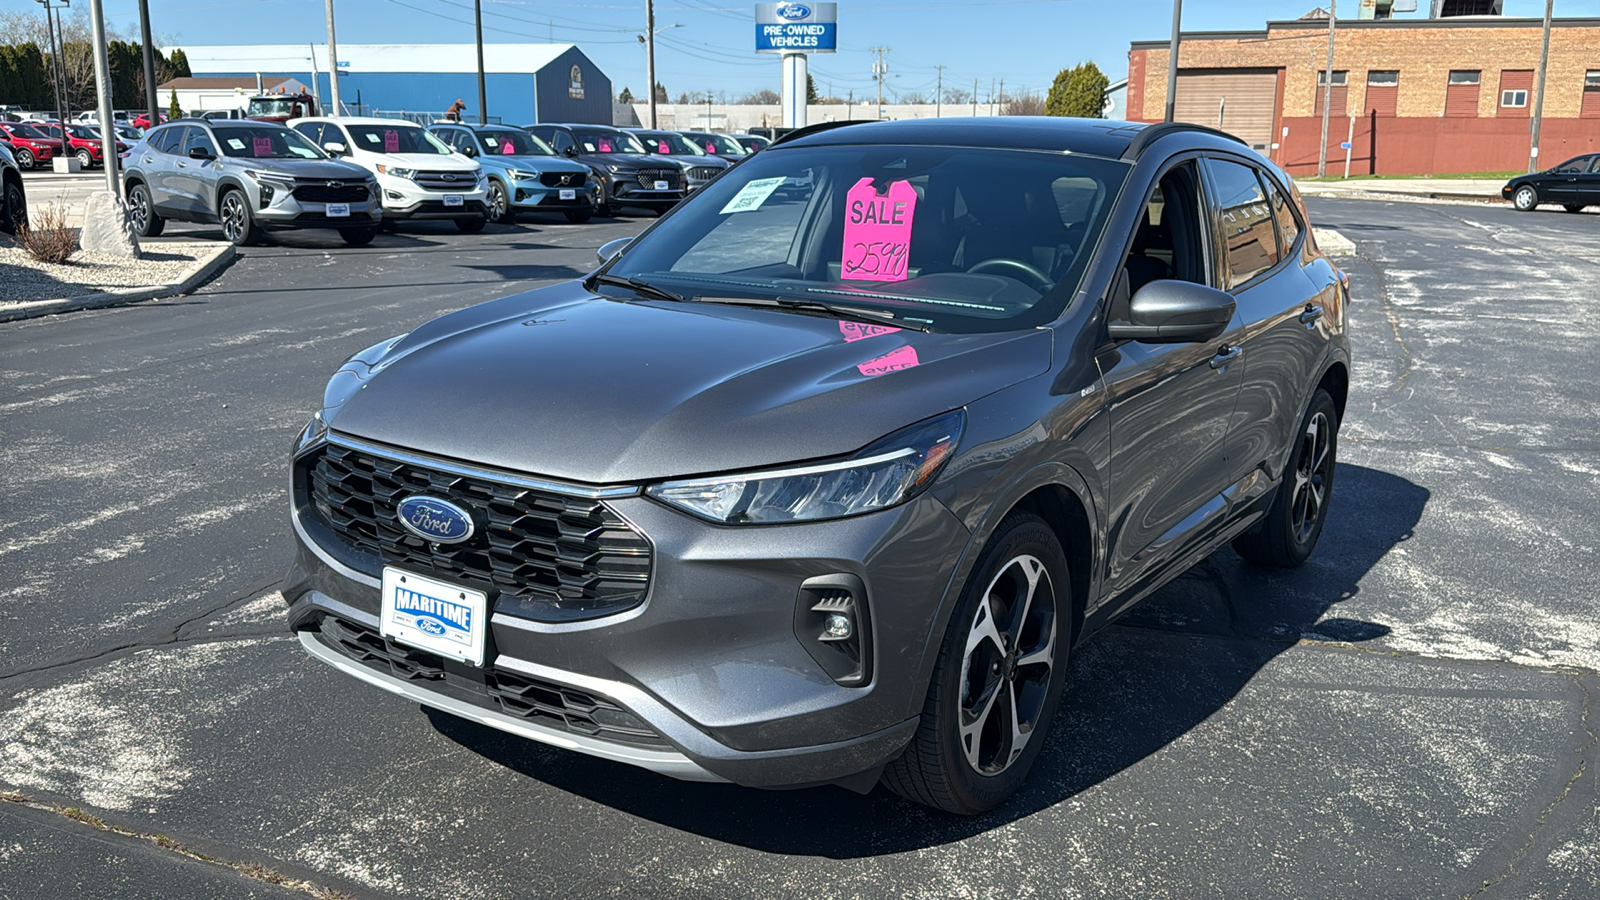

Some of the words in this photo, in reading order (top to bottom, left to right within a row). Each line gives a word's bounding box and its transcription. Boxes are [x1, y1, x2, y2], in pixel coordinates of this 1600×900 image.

[783, 7, 803, 17] Ford
[764, 25, 825, 36] PRE-OWNED
[770, 36, 818, 47] VEHICLES
[850, 200, 906, 225] SALE
[411, 505, 453, 534] Ford
[396, 589, 470, 630] MARITIME
[420, 619, 442, 635] Ford
